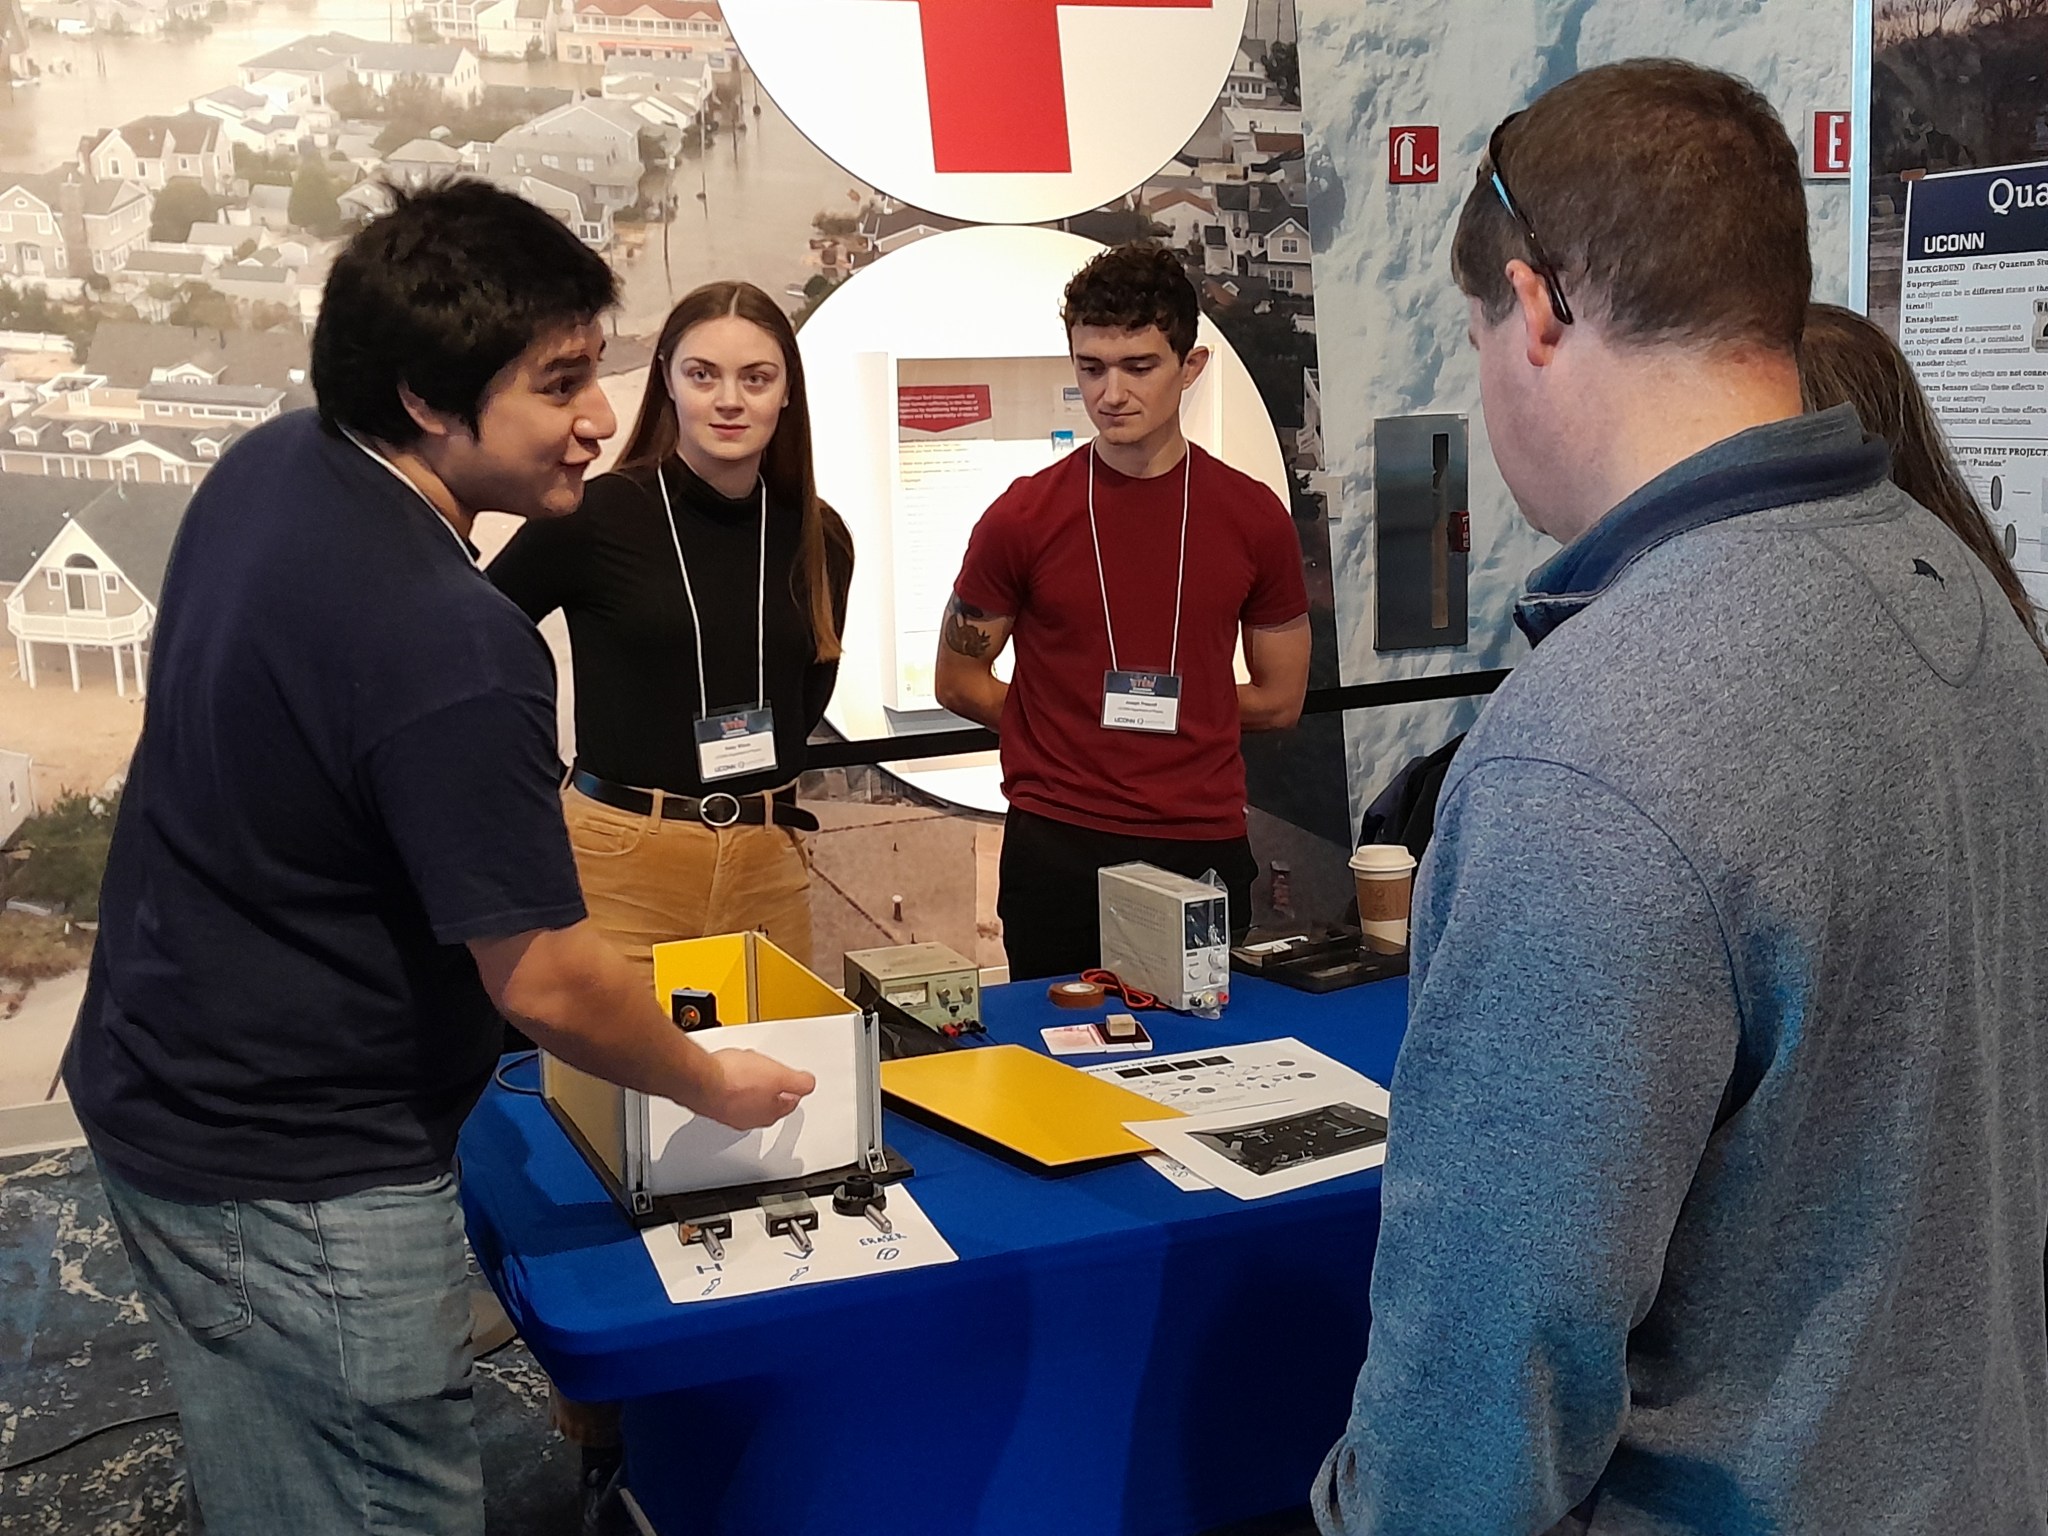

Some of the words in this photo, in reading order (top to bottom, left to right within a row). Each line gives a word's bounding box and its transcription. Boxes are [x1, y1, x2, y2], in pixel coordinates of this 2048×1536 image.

[1924, 232, 1985, 253] UCONN
[1908, 263, 1965, 275] BACKGROUND
[1972, 262, 1997, 271] (Fancy
[1999, 260, 2035, 268] Quantum
[1906, 280, 1959, 289] Superposition:
[1918, 288, 1940, 300] object
[1954, 288, 1962, 297] be
[1972, 286, 2004, 295] different
[2005, 286, 2026, 294] states
[1905, 315, 1959, 324] Entanglement:
[1965, 324, 2011, 332] measurement
[1916, 337, 1939, 347] object
[1941, 336, 1962, 344] affects
[1988, 335, 2024, 343] correlated
[1969, 347, 1975, 355] of
[1983, 347, 2030, 355] measurement
[1941, 370, 1945, 378] if
[1971, 370, 1994, 379] objects
[1953, 395, 1986, 404] sensitivity
[1939, 418, 1976, 426] omputation
